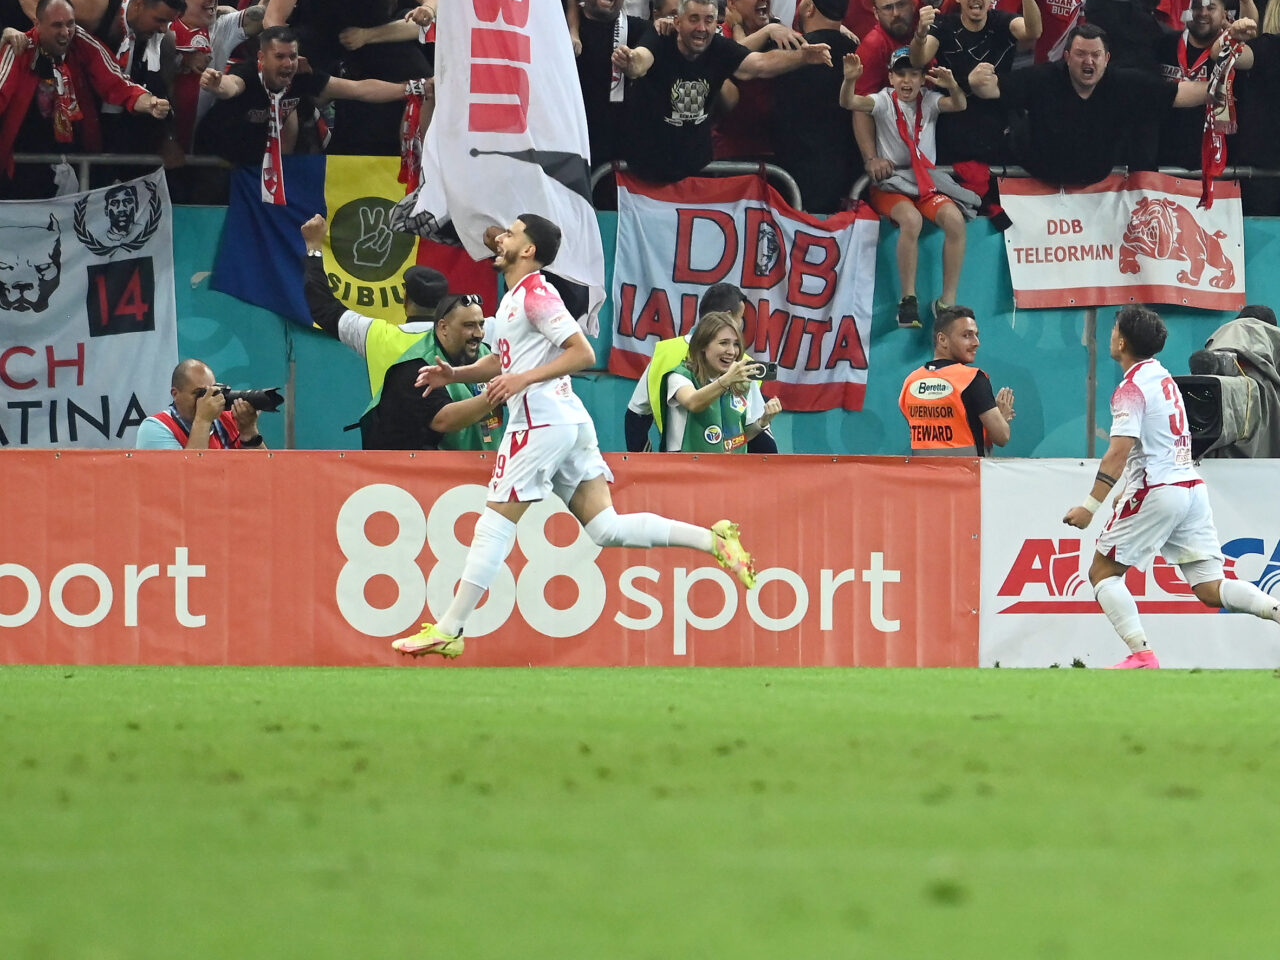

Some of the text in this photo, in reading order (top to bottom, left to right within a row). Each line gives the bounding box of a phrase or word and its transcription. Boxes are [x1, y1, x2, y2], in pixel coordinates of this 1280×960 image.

[1047, 218, 1083, 235] DDB
[673, 207, 841, 308] DDB
[1013, 243, 1114, 264] TELEORMAN
[95, 266, 149, 327] 14
[918, 382, 946, 394] Beretta
